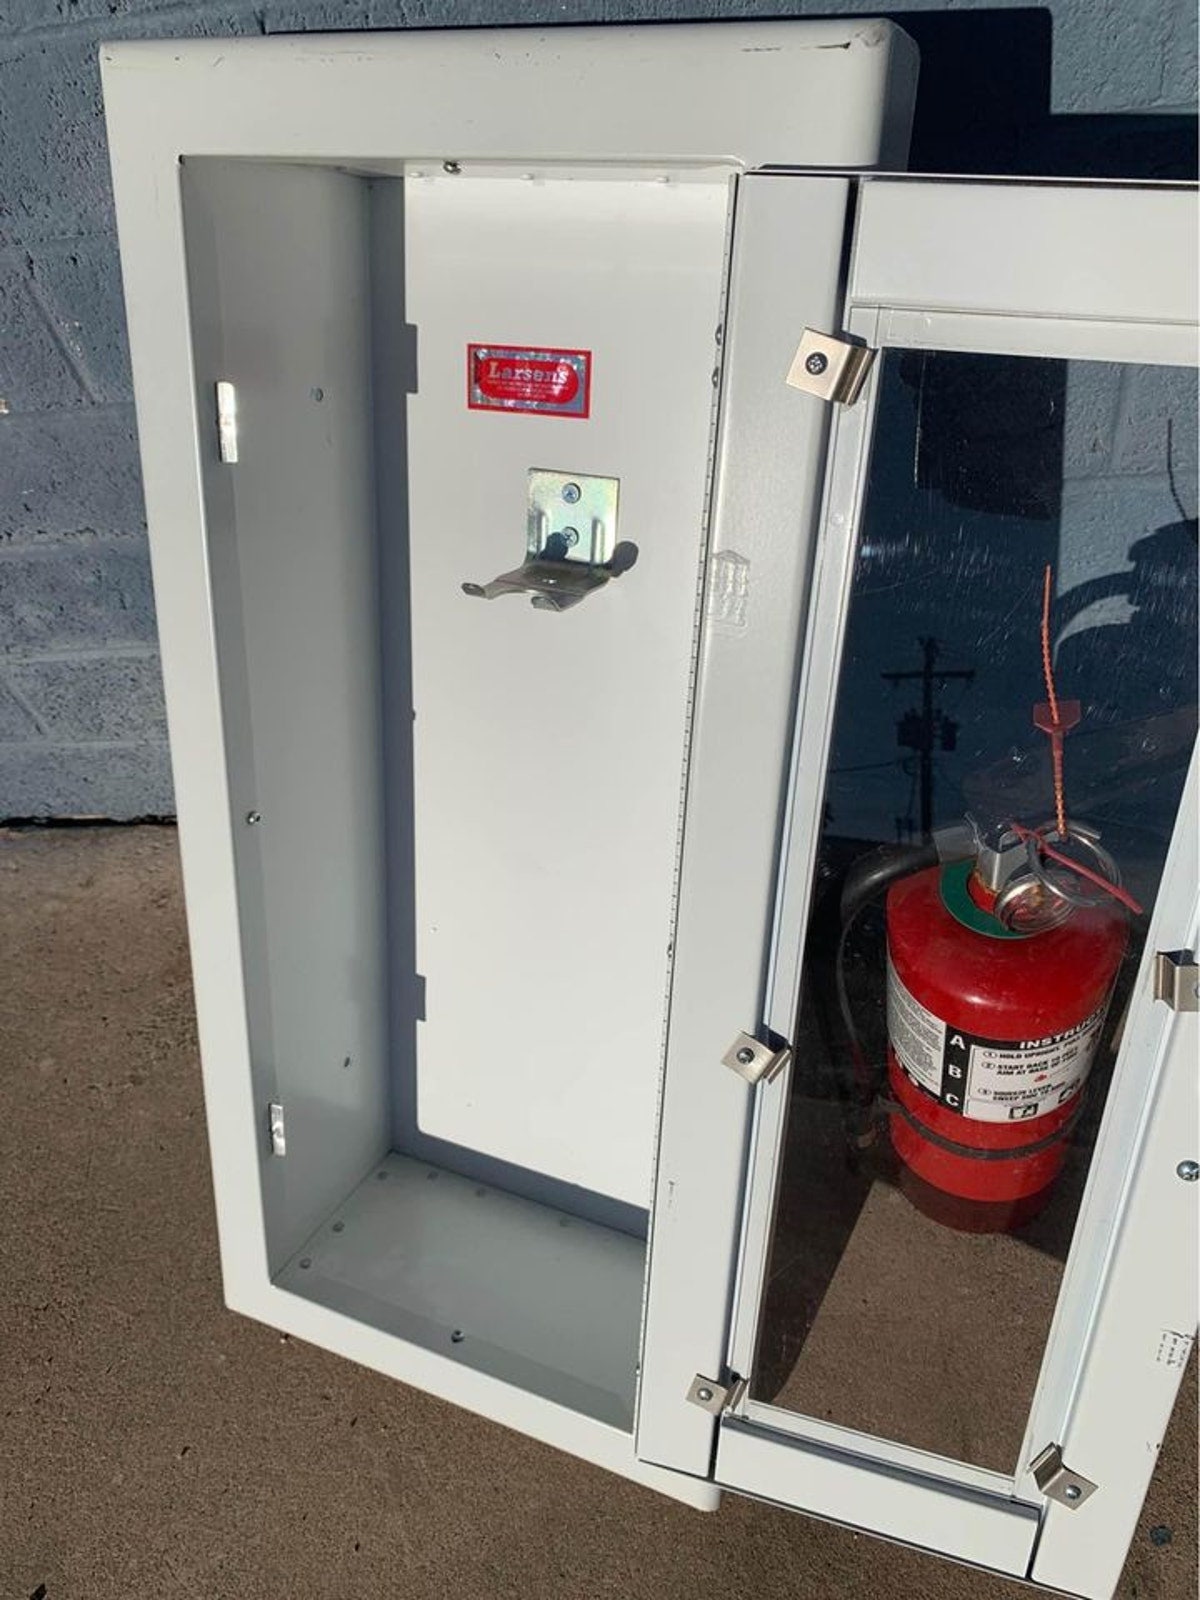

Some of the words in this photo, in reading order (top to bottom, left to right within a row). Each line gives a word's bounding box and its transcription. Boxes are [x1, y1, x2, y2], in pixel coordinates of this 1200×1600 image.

[949, 1034, 965, 1050] A
[948, 1064, 962, 1079] B
[946, 1092, 959, 1106] C
